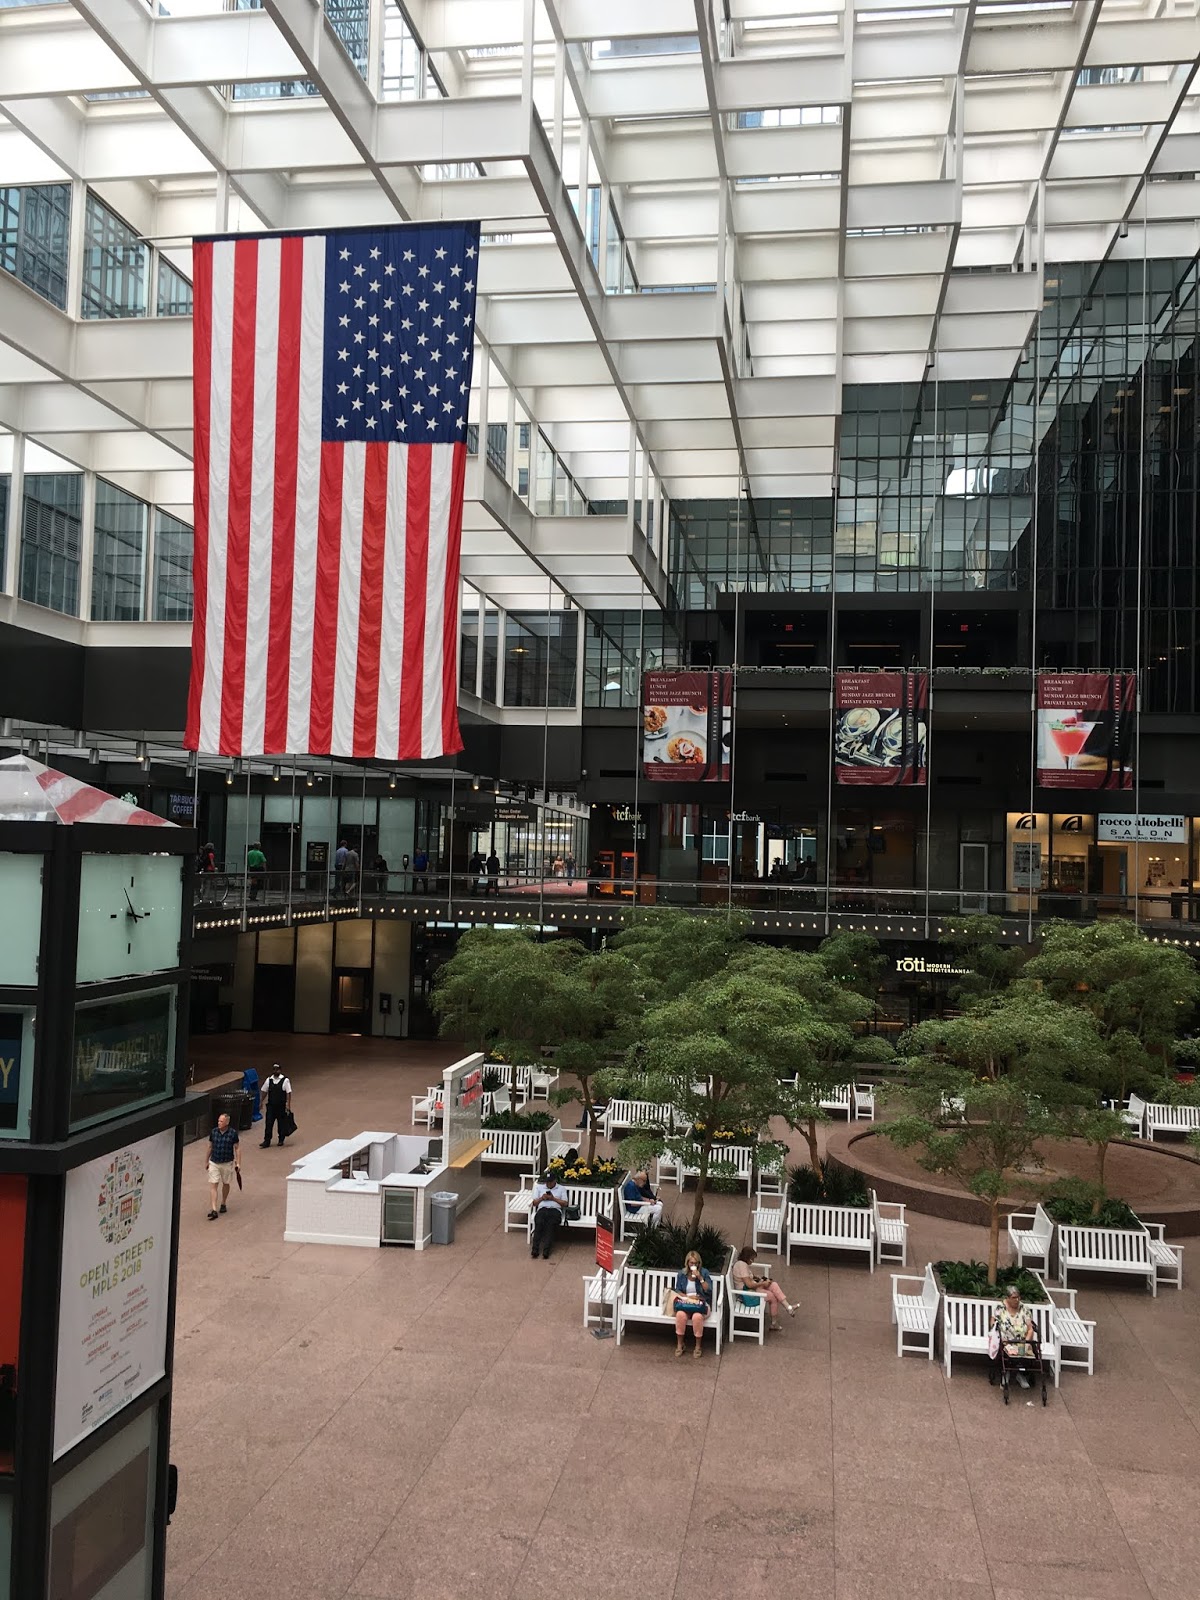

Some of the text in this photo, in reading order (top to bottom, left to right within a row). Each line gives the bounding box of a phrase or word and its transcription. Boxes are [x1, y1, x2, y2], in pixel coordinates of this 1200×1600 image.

[172, 804, 193, 815] COFFEE
[1099, 817, 1184, 828] rocco altobelli
[1110, 829, 1173, 837] SALON
[79, 1236, 154, 1288] OPEN STREETS
[92, 1272, 118, 1299] MPLS
[120, 1258, 142, 1282] 2018
